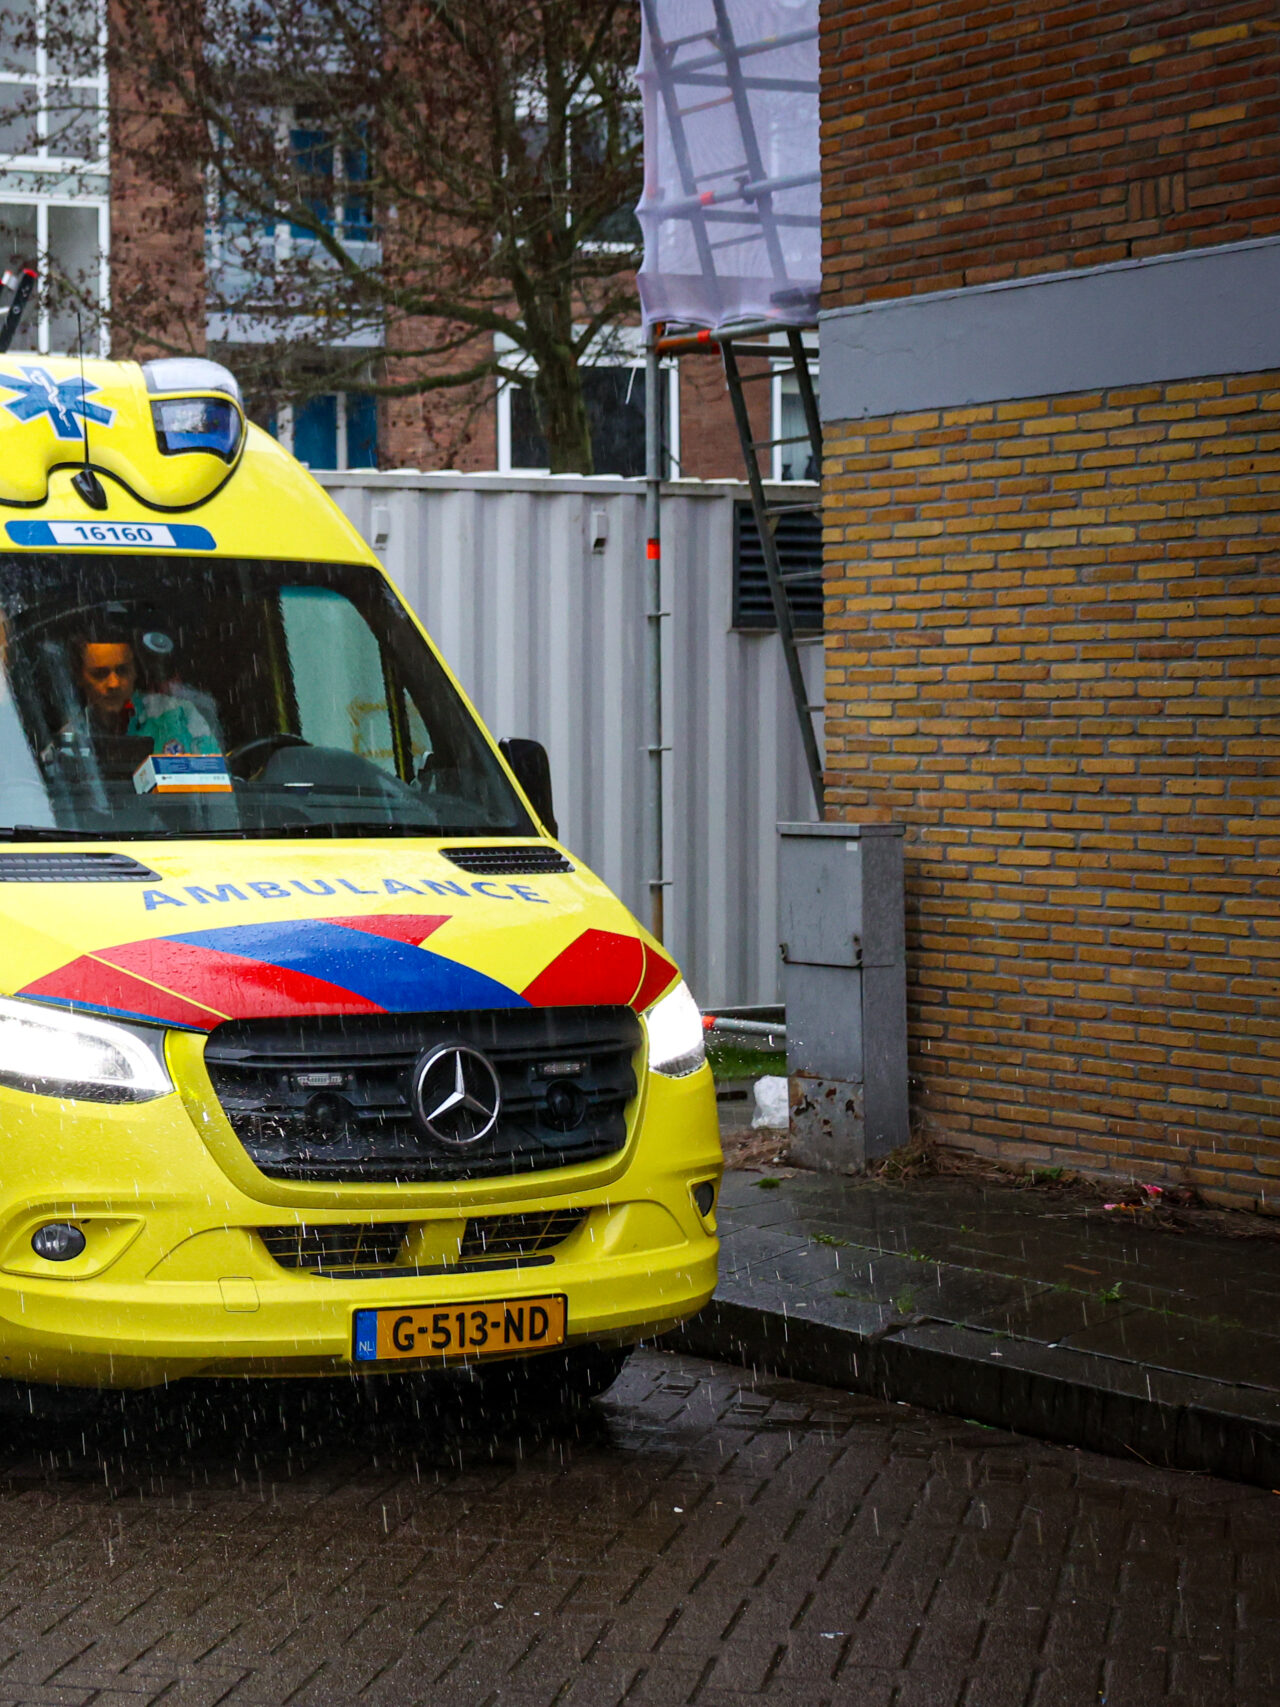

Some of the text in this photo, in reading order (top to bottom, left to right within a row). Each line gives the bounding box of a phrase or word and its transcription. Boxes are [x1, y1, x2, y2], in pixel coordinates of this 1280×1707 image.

[74, 526, 153, 542] 16160
[144, 878, 550, 911] AMBULANCE
[392, 1306, 549, 1352] G-513-ND
[359, 1341, 373, 1352] NL
